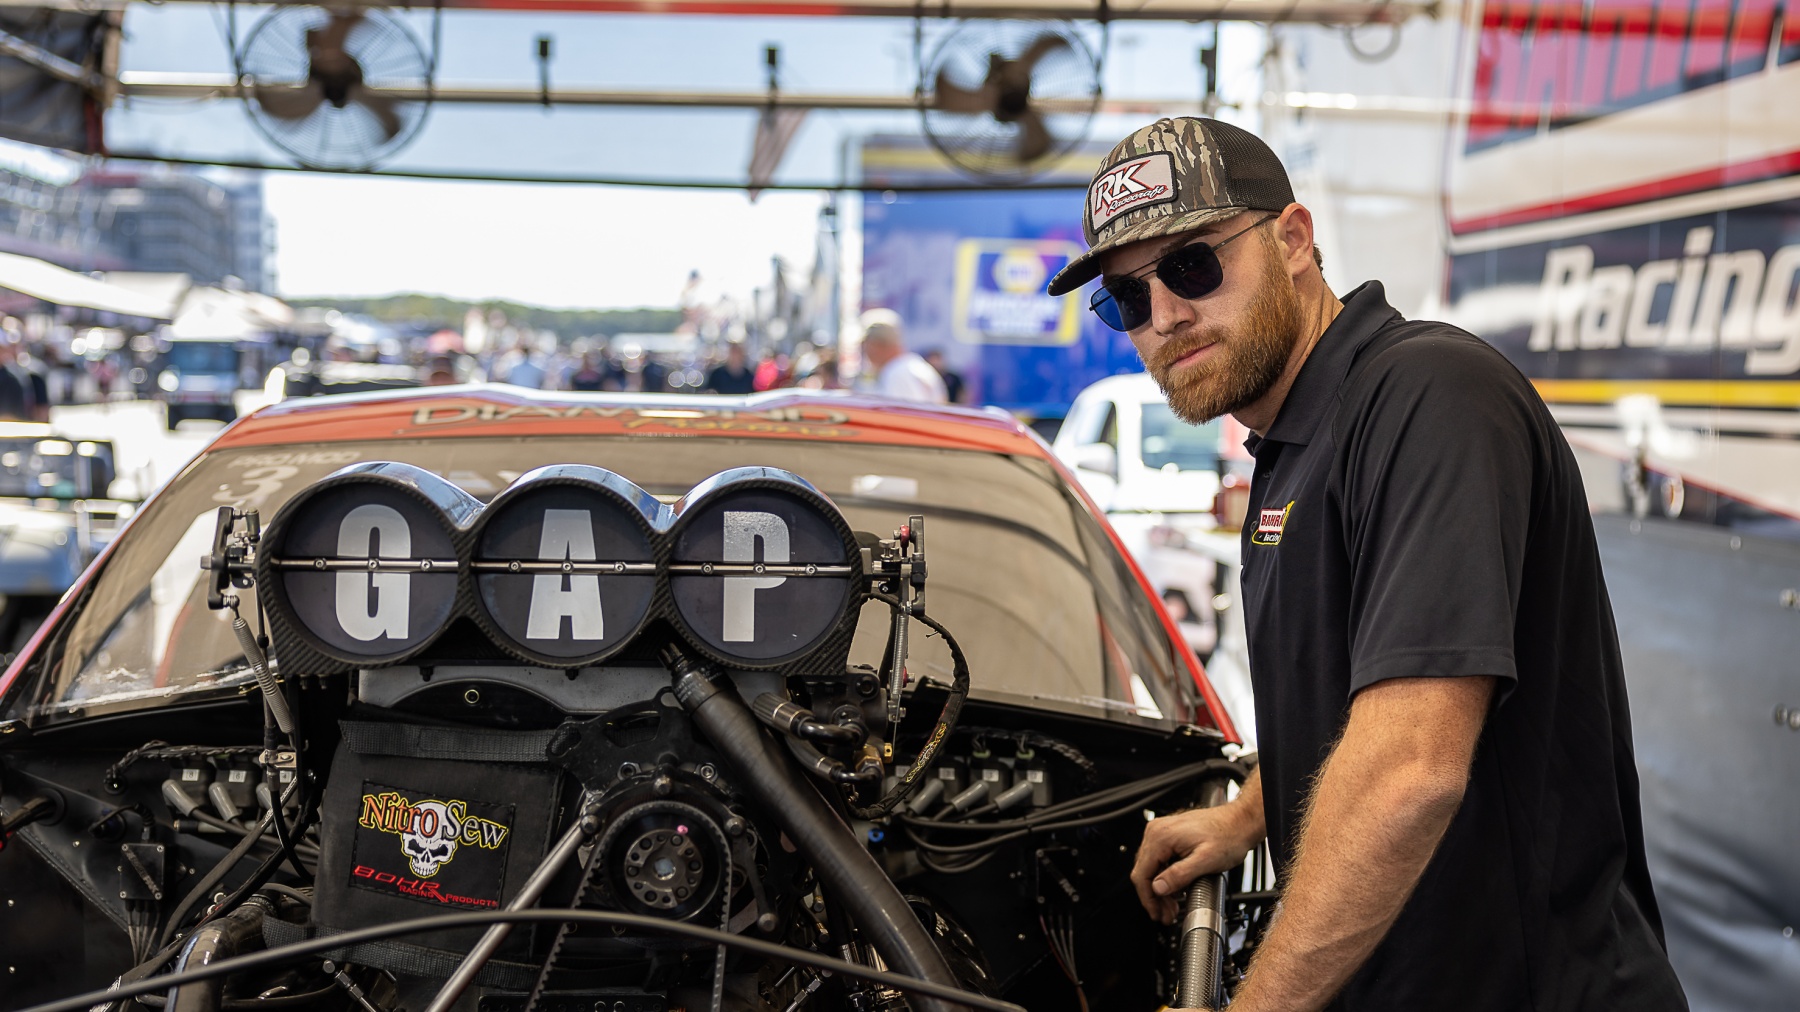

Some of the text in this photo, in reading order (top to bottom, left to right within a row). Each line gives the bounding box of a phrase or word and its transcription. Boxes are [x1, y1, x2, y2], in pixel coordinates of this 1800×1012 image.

[1095, 163, 1148, 213] RK
[1107, 186, 1168, 214] Racecraft
[1528, 226, 1800, 375] Racing
[412, 404, 850, 425] DIAMND
[212, 466, 298, 503] 3
[399, 885, 498, 907] RACING PRODUCTS
